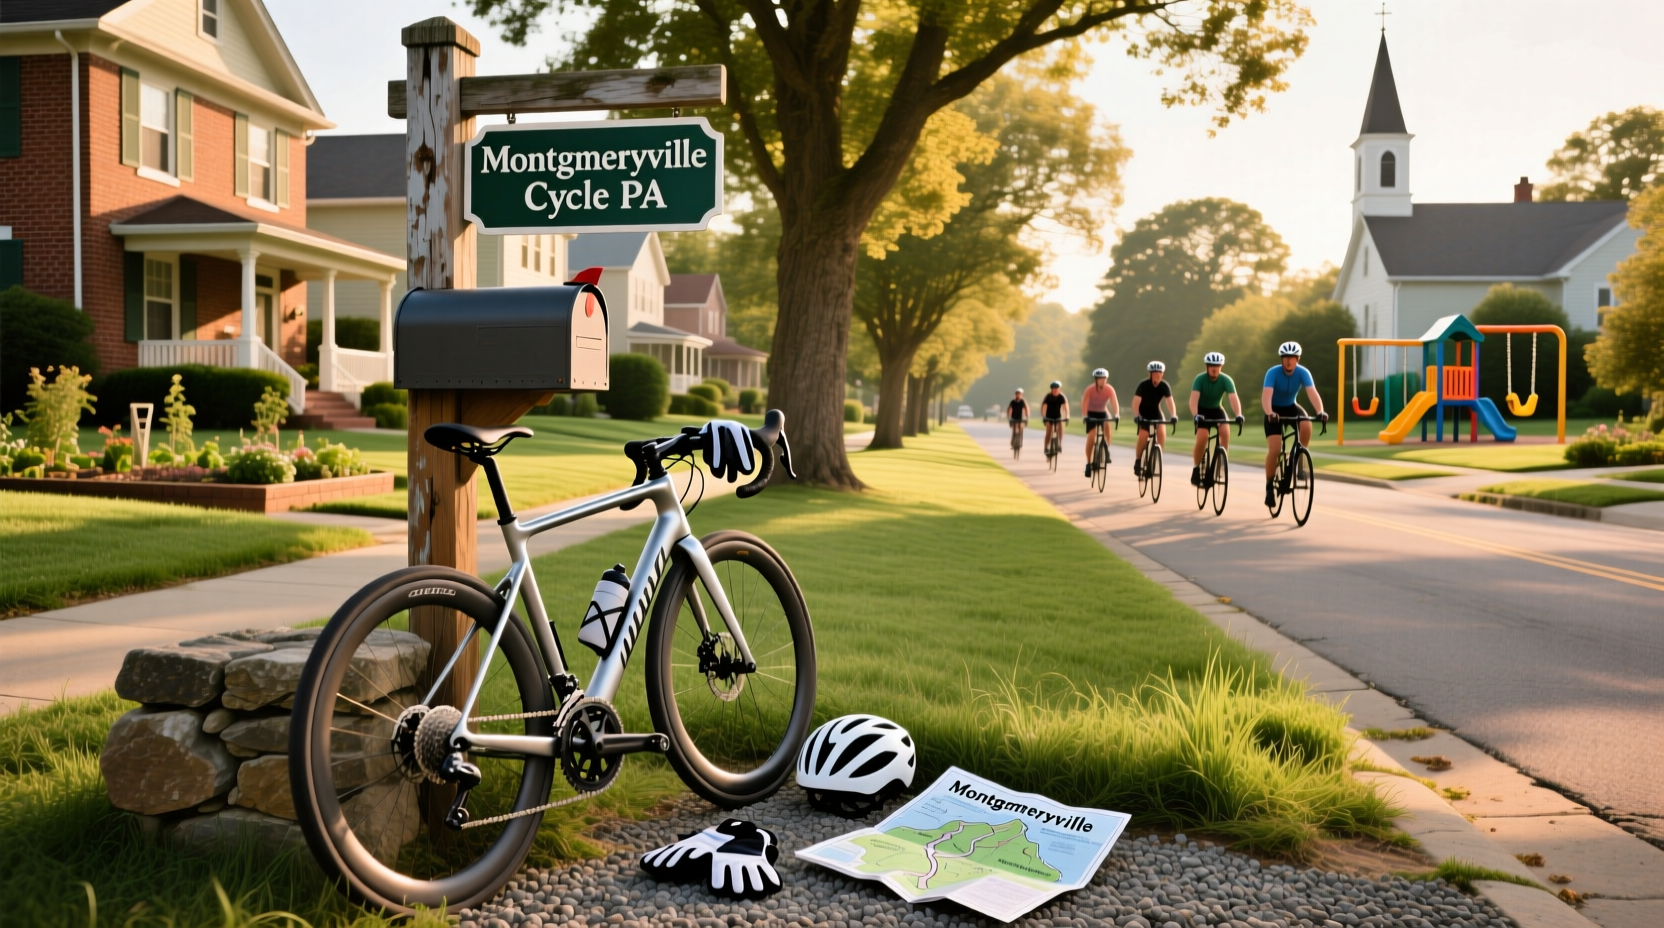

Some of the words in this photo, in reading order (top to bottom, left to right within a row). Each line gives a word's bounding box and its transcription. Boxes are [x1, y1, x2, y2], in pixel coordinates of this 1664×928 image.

[480, 138, 707, 180] Montgmeryville
[524, 179, 610, 220] Cycle
[620, 178, 668, 210] PA
